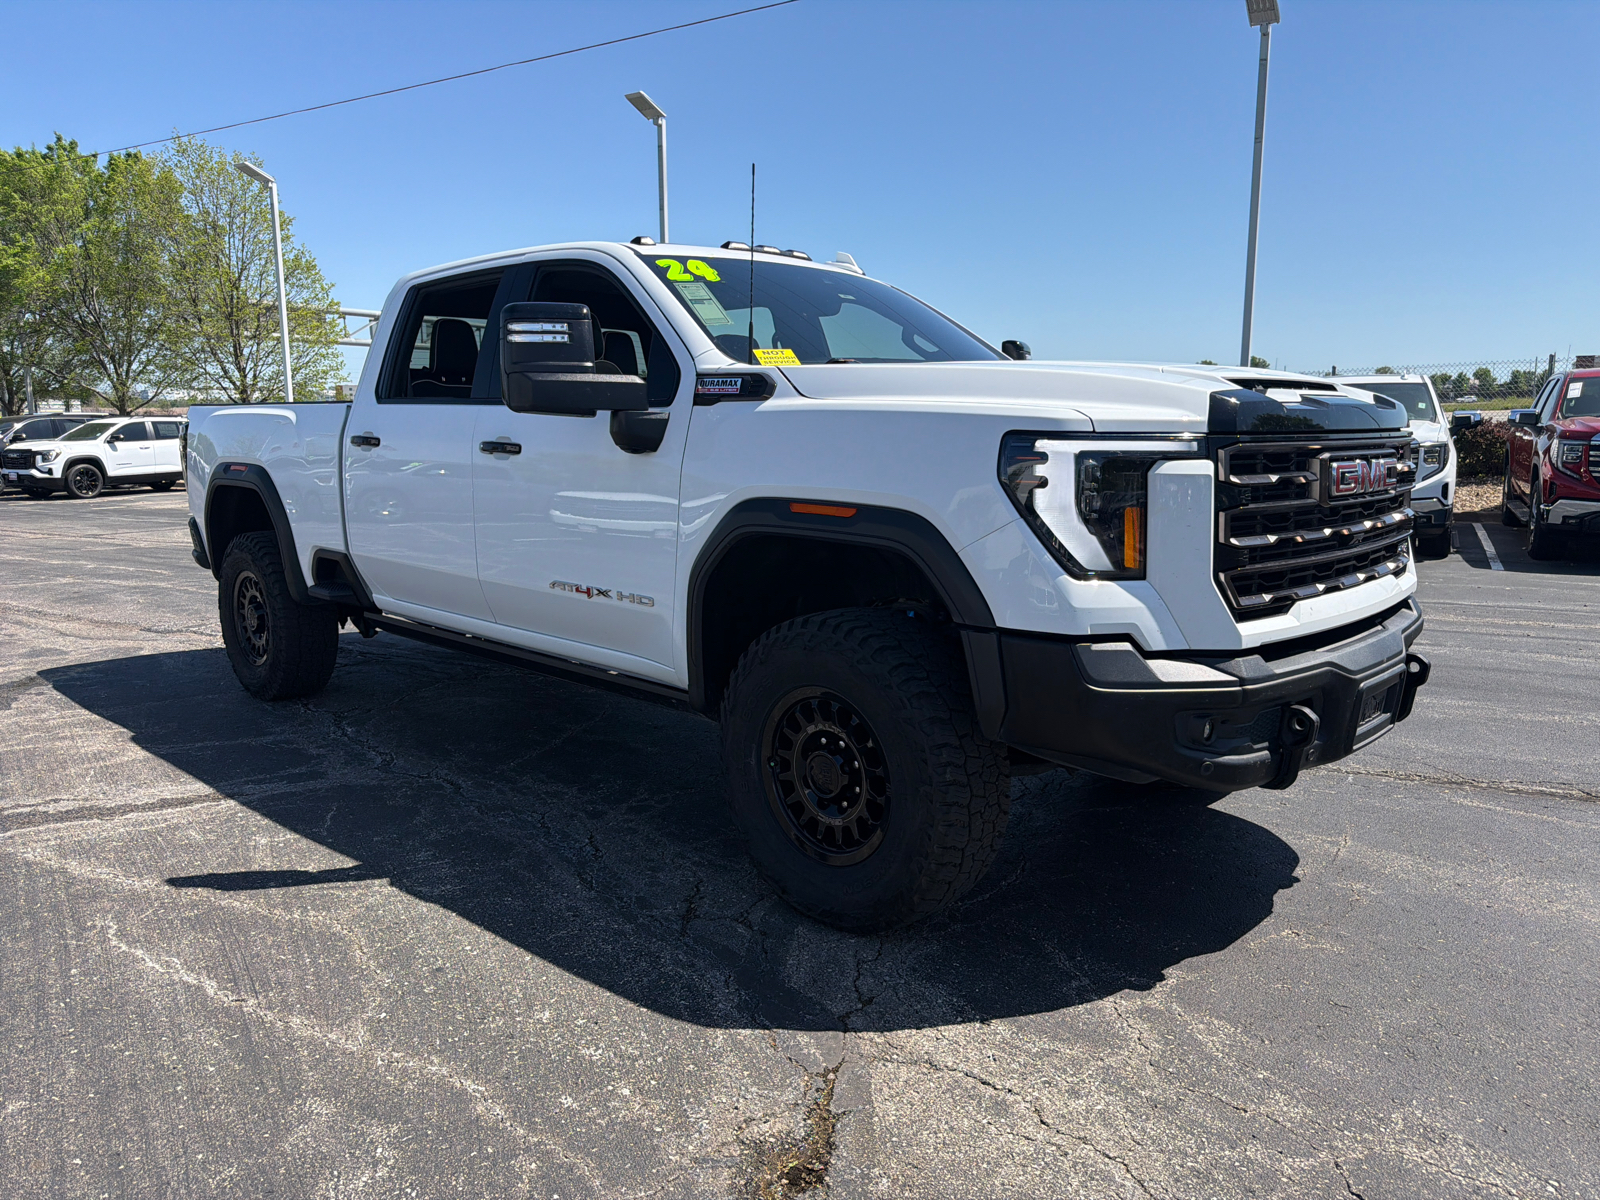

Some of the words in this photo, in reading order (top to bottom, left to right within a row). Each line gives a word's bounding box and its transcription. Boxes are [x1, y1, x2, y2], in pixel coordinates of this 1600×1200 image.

[655, 259, 721, 282] 24
[699, 379, 739, 387] DURAMAX
[1330, 458, 1397, 497] GMC
[549, 580, 613, 599] AT4X
[616, 591, 655, 607] HD
